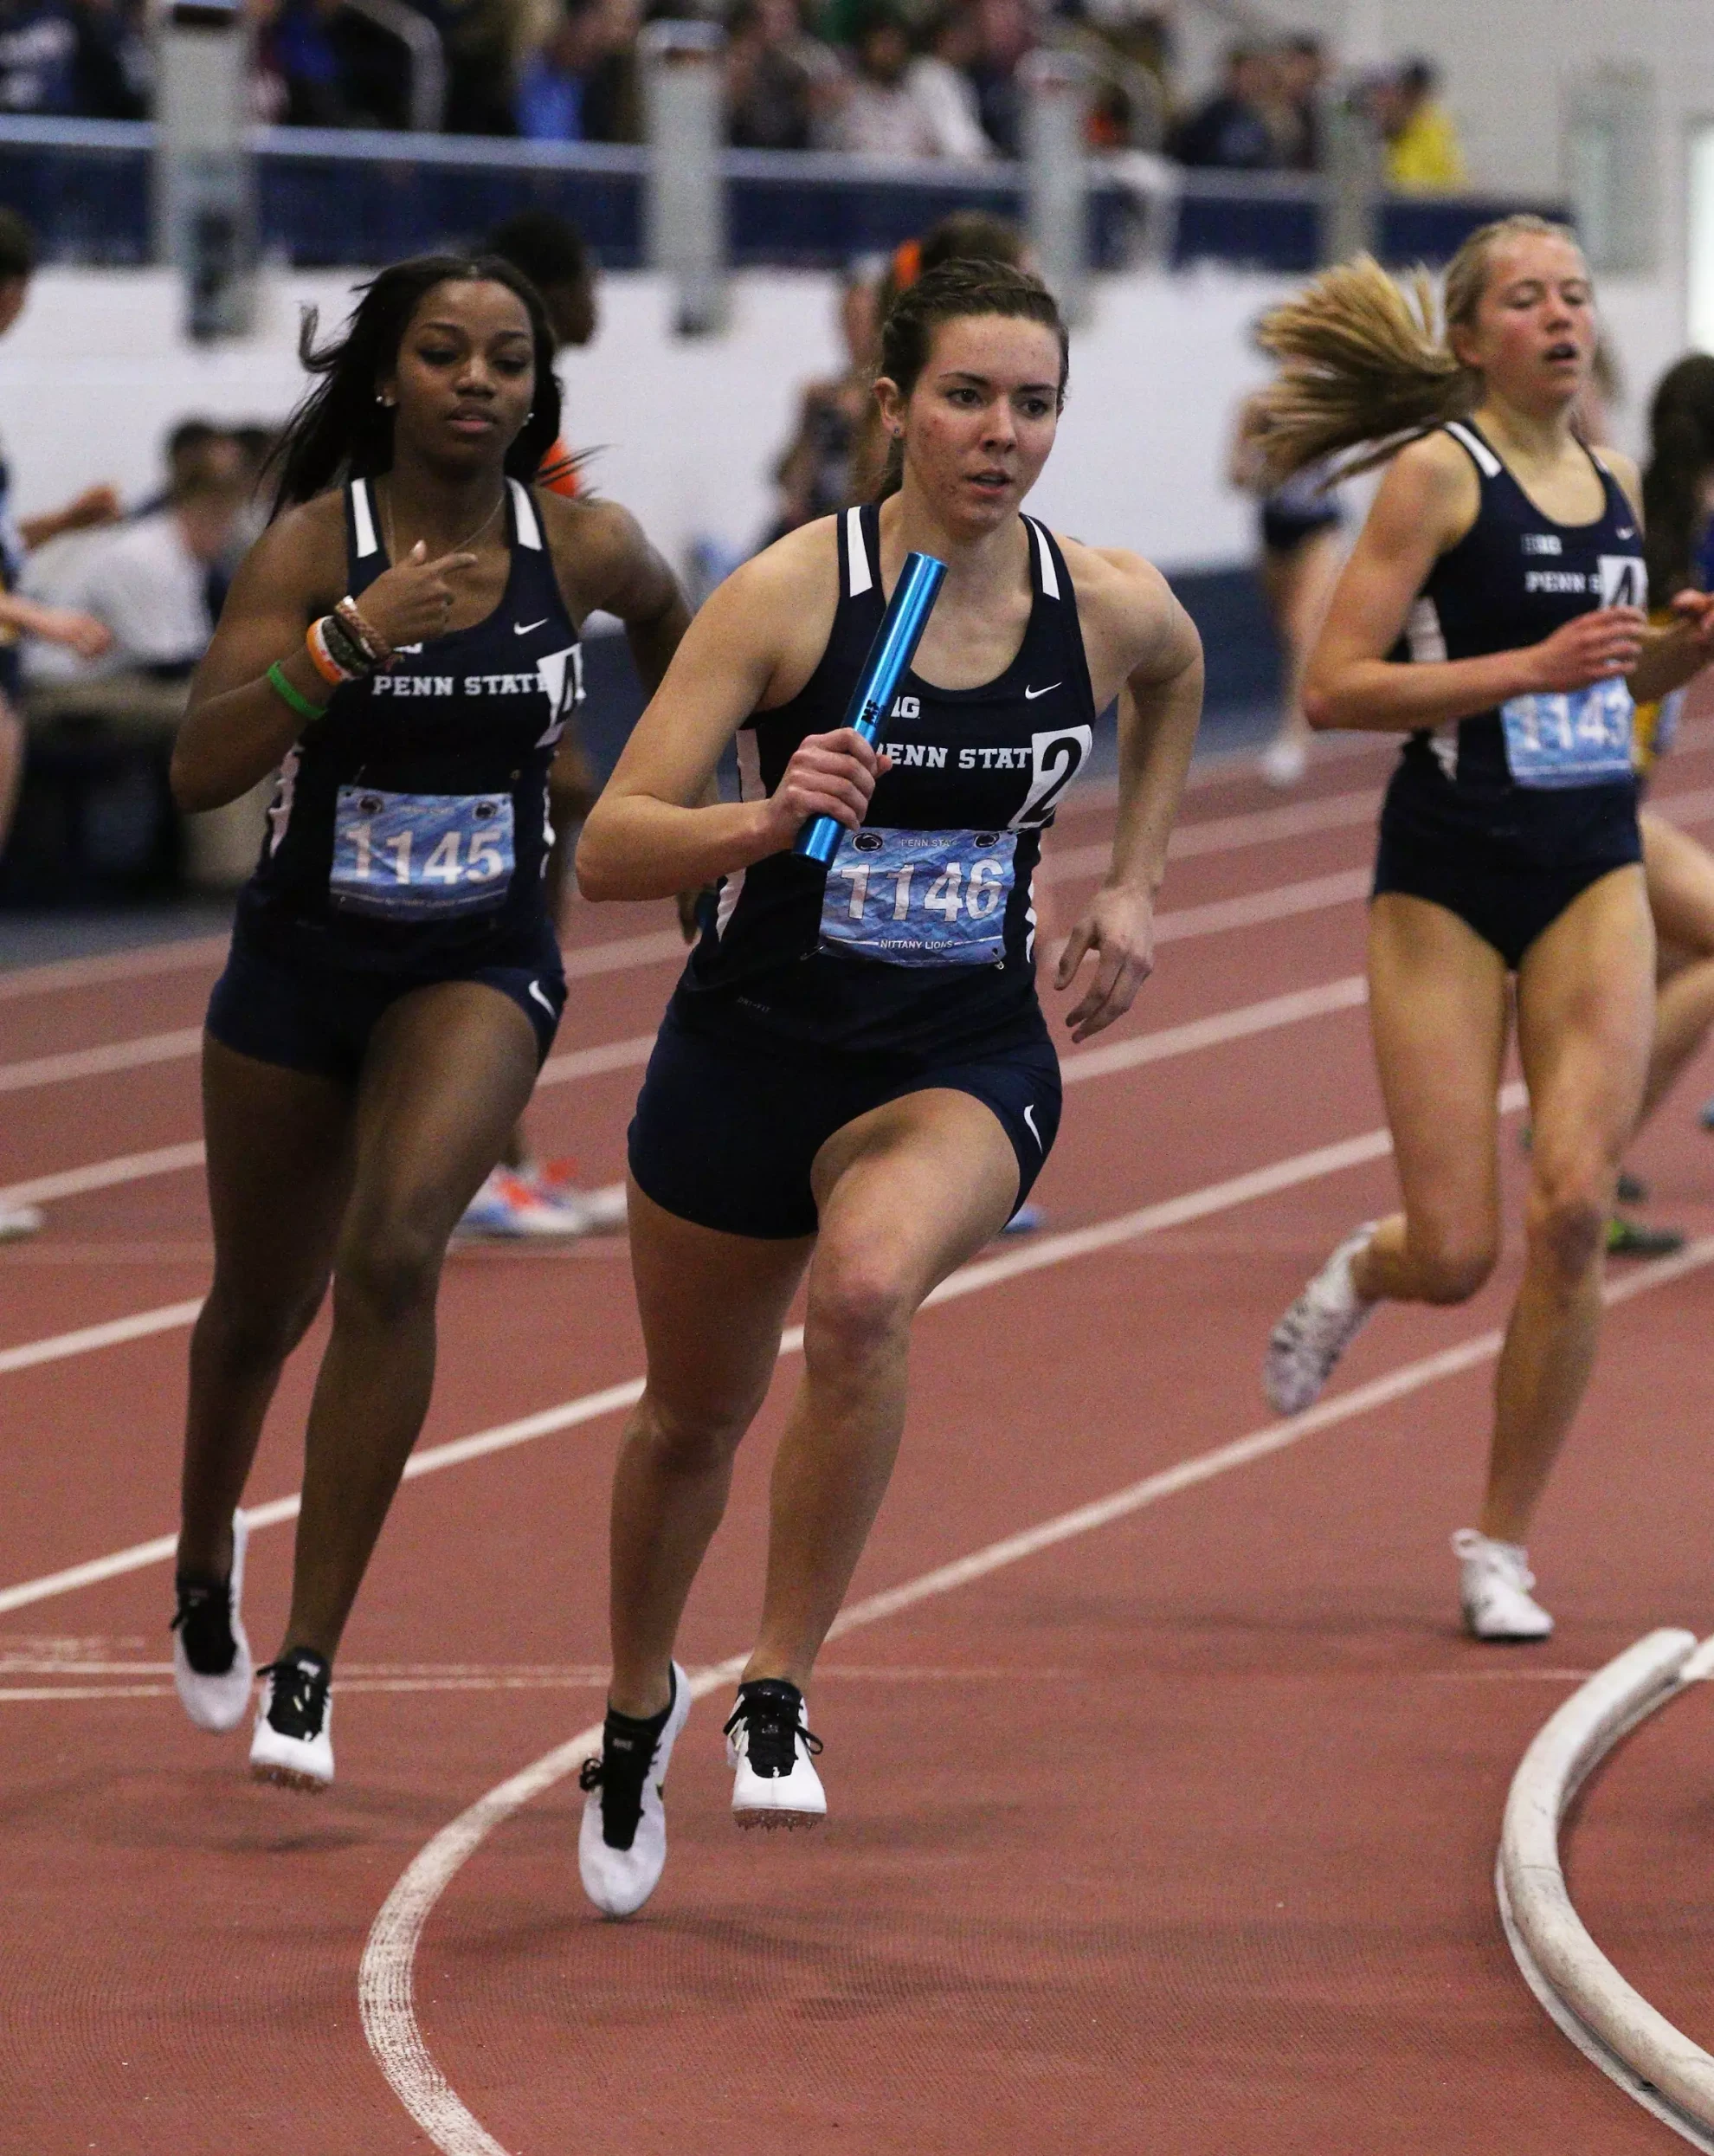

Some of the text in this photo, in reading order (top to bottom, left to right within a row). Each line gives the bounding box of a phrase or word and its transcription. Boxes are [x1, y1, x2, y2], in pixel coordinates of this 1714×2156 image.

[1524, 571, 1586, 593] PENN
[371, 675, 453, 696] PENN
[958, 747, 1032, 769] STAT
[1017, 737, 1082, 823] 2
[347, 824, 504, 885] 1145
[841, 859, 1004, 922] 1146
[880, 939, 953, 950] NITTANY LIONS
